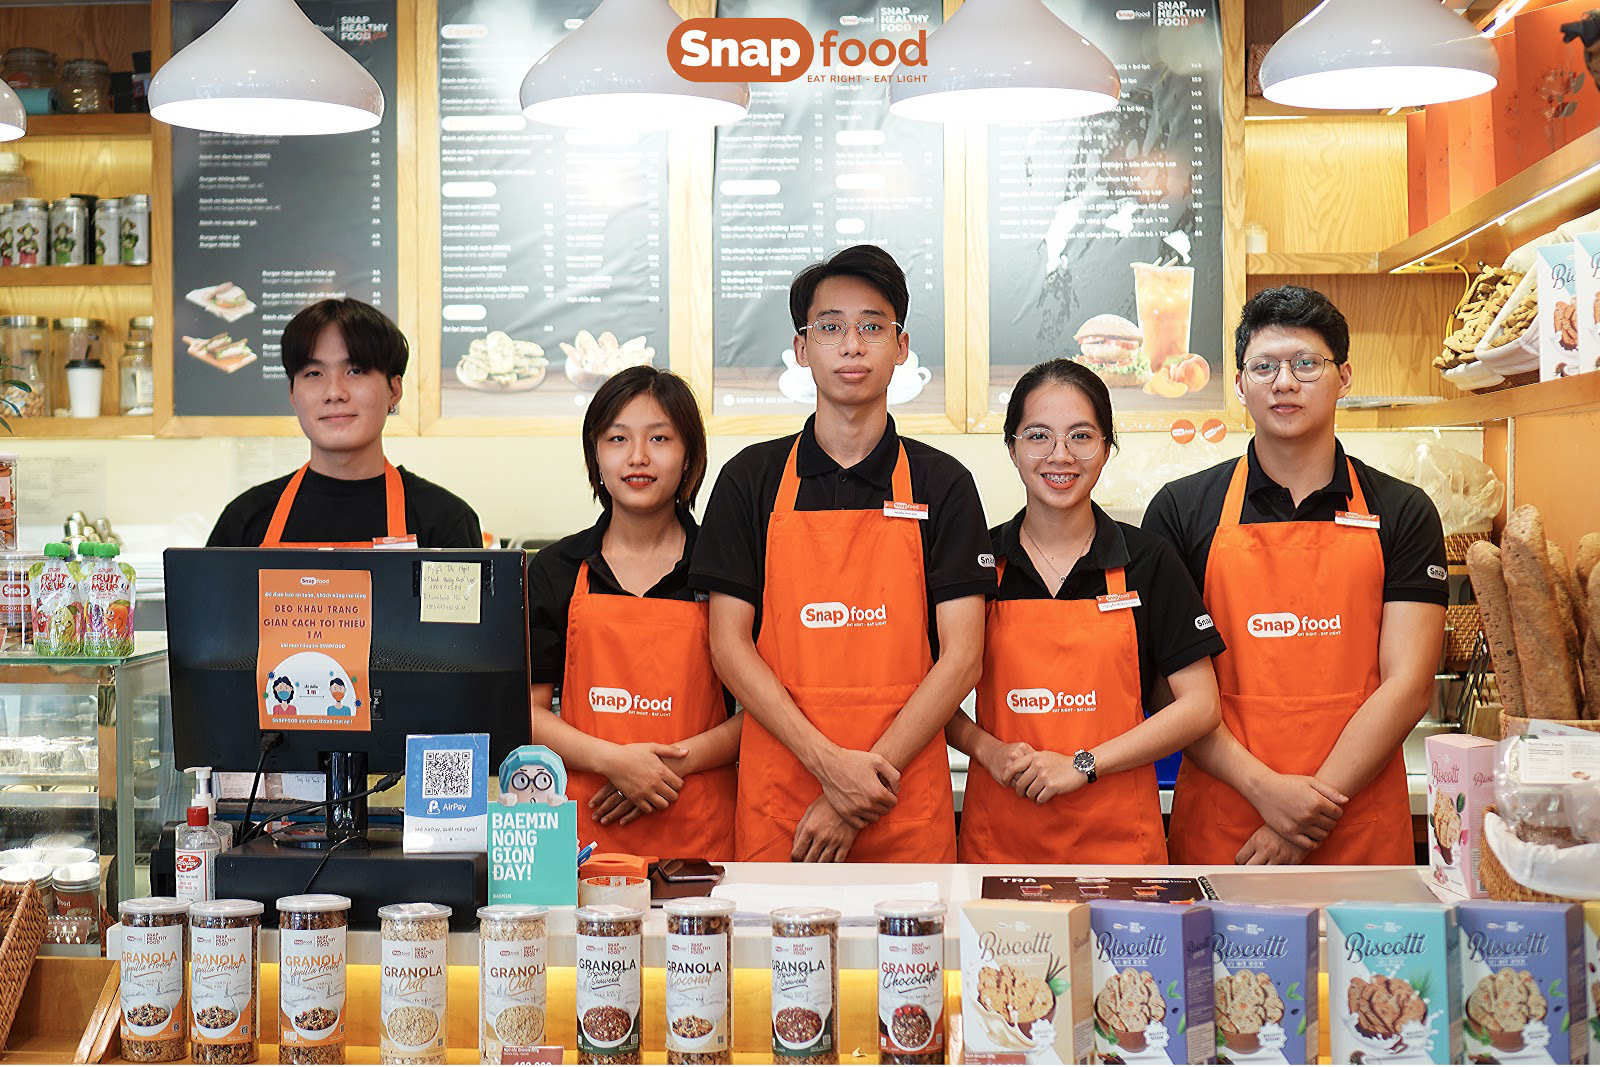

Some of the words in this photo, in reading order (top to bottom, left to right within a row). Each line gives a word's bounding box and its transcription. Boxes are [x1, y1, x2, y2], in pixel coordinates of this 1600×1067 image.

[880, 6, 911, 16] SNAP
[1157, 1, 1187, 10] SNAP
[340, 16, 370, 24] SNAP
[880, 14, 930, 24] HEALTHY
[1157, 9, 1206, 18] HEALTHY
[340, 23, 388, 32] HEALTHY
[880, 24, 912, 32] FOOD
[1157, 18, 1189, 27] FOOD
[340, 32, 372, 41] FOOD
[40, 573, 70, 584] FRUIT
[92, 574, 122, 584] FRUIT
[274, 604, 293, 612] ĐEO
[328, 606, 359, 614] TRANG
[806, 608, 844, 624] Snap
[850, 604, 887, 621] food
[1252, 618, 1295, 634] Snap
[1301, 614, 1341, 630] food
[307, 630, 311, 638] 1
[313, 630, 322, 639] M
[591, 692, 627, 710] Snap
[633, 694, 672, 711] food
[1010, 694, 1050, 710] Snap
[1056, 690, 1096, 706] food
[1432, 760, 1460, 788] Biscotti
[443, 802, 466, 812] AirPay
[492, 812, 559, 829] BAEMIN
[492, 864, 532, 881] ĐÂY!
[979, 931, 1052, 962] Biscotti
[1096, 931, 1166, 962] Biscotti
[1212, 933, 1288, 964] Biscotti
[1346, 931, 1428, 963] Biscotti
[1469, 931, 1549, 962] Biscotti
[122, 951, 178, 964] GRANOLA
[285, 952, 344, 966] GRANOLA
[148, 959, 172, 972] Honey
[216, 961, 240, 974] Honey
[318, 962, 340, 973] Honey
[384, 965, 443, 978] GRANOLA
[490, 962, 546, 978] GRANOLA
[579, 958, 636, 972] GRANOLA
[667, 960, 722, 974] GRANOLA
[772, 960, 825, 972] GRANOLA
[882, 961, 940, 974] GRANOLA
[399, 976, 426, 992] Oats
[508, 975, 536, 992] Oats
[669, 969, 714, 988] Coconut
[882, 968, 937, 988] Chocolate
